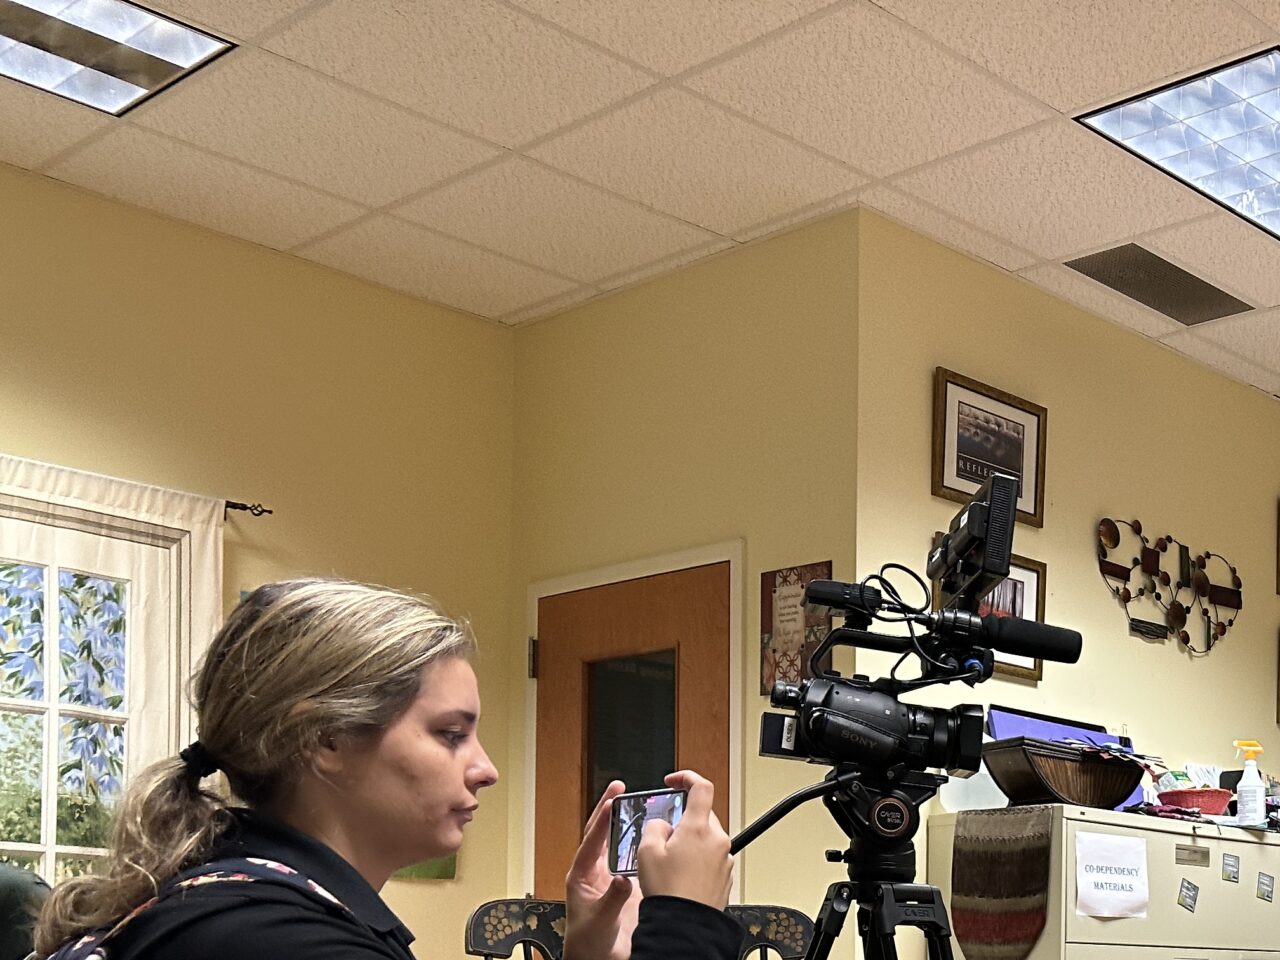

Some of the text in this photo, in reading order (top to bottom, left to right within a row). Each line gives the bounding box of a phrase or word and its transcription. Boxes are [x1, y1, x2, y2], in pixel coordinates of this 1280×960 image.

[958, 459, 993, 477] REFLEC
[841, 728, 877, 749] SONY
[1084, 864, 1140, 877] CO-DEPENDENCY
[1093, 881, 1134, 892] MATERIALS
